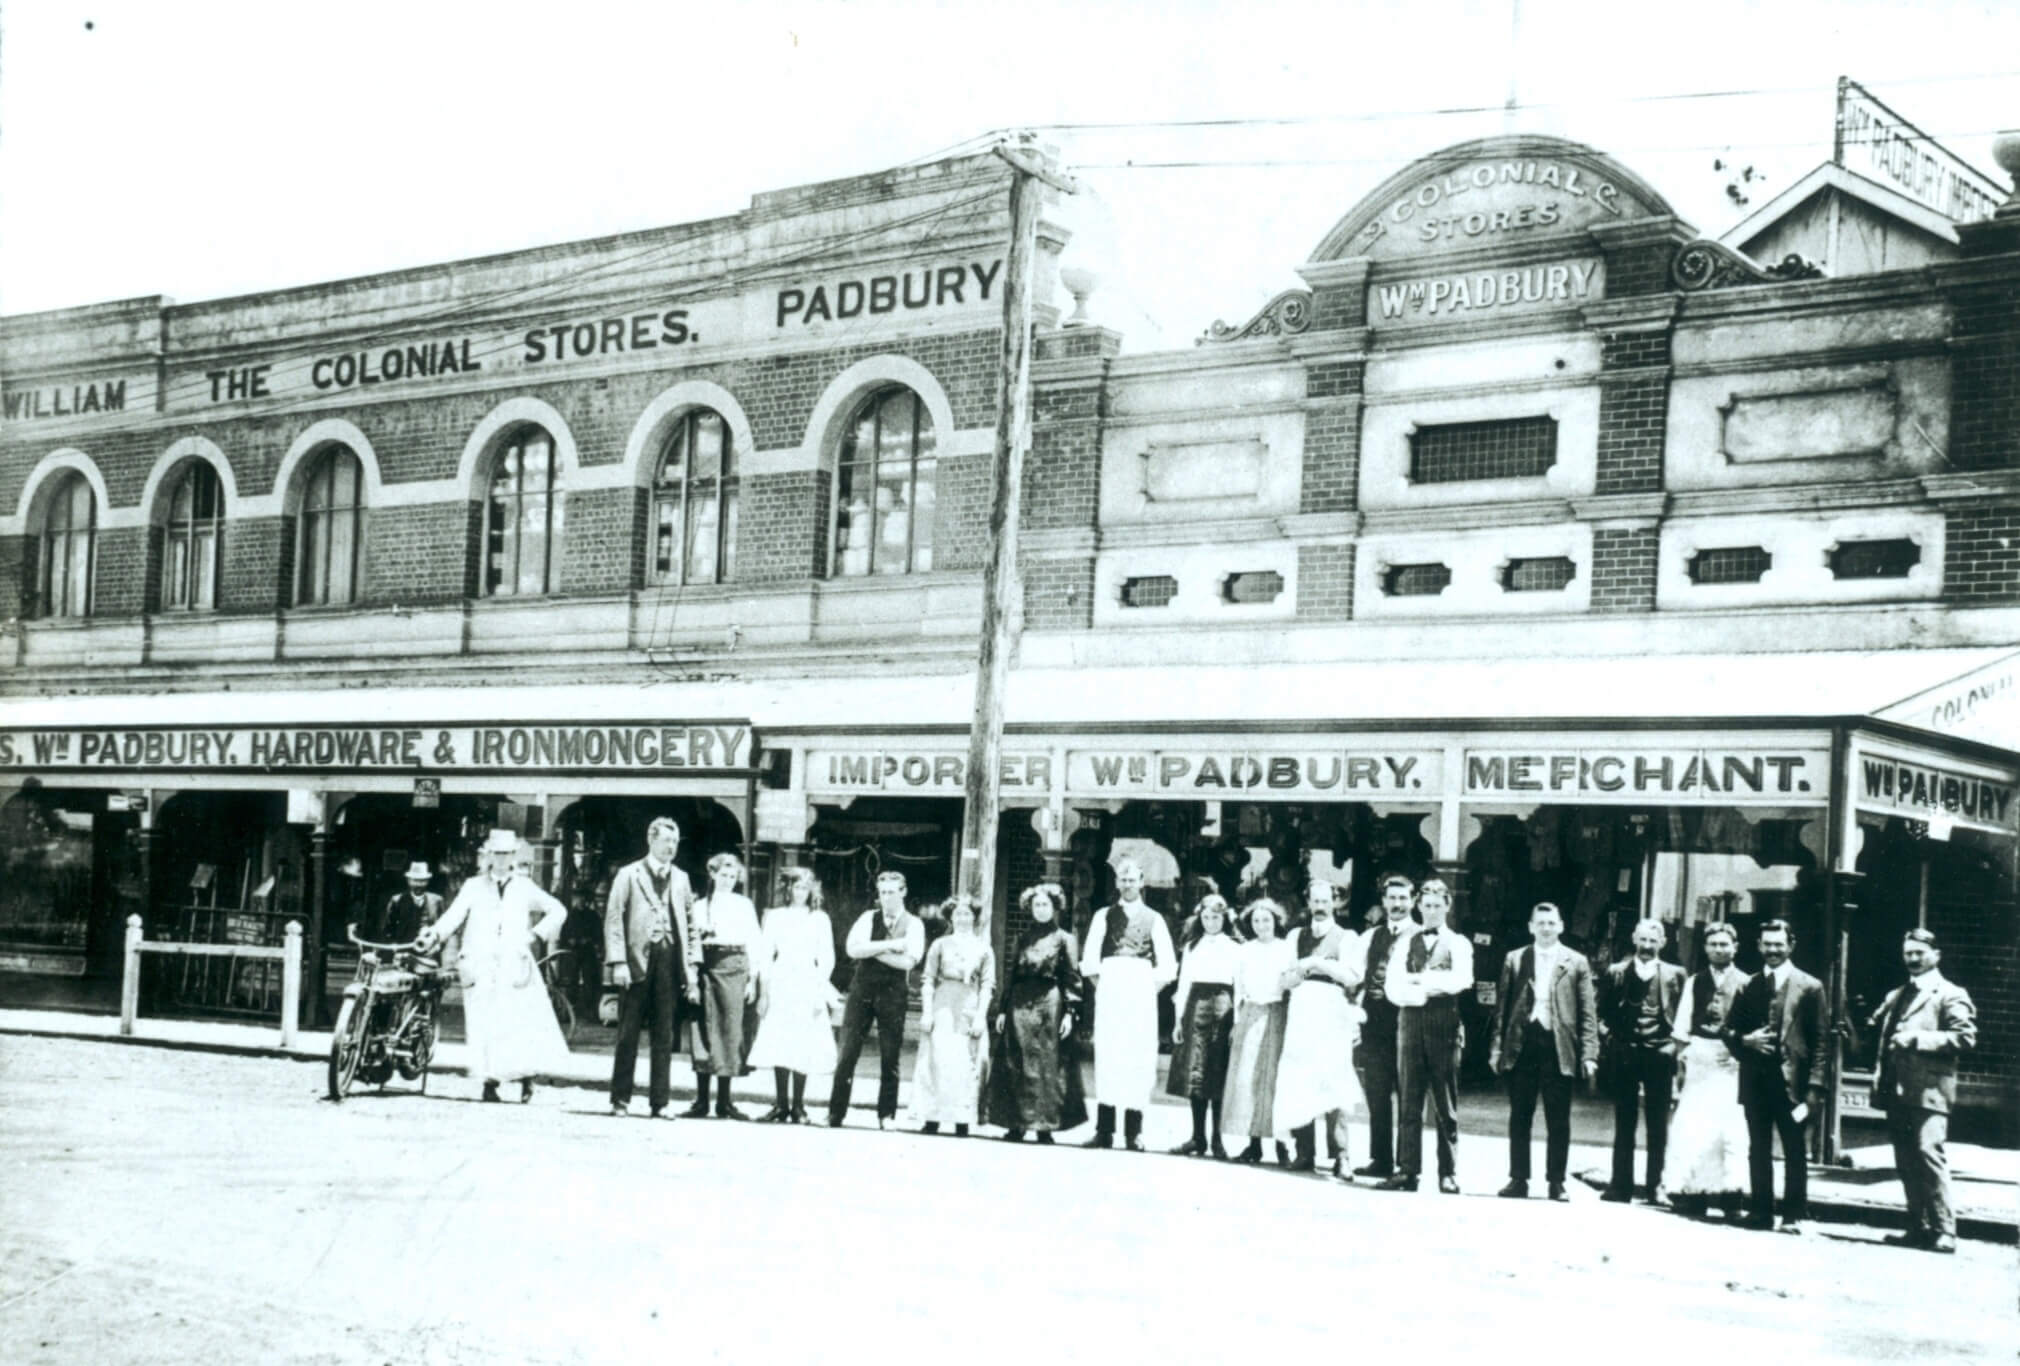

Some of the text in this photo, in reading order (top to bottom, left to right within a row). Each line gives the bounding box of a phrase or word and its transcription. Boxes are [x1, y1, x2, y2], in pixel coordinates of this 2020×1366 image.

[1391, 162, 1586, 224] COLONIAL
[1418, 202, 1561, 242] STORES
[776, 259, 1003, 328] PADBURY
[1427, 261, 1598, 315] PADBURY
[2, 309, 700, 420] WILLIAM THE COLONIAL STORES.
[80, 732, 238, 765] PADBURY.
[251, 730, 423, 766] HARDWARE
[433, 730, 457, 765] &
[472, 727, 746, 767] IRONMONGERY
[827, 755, 1051, 787] IMPORER
[1159, 756, 1423, 790] PADBURY.
[1467, 755, 1812, 792] MERCHANT.
